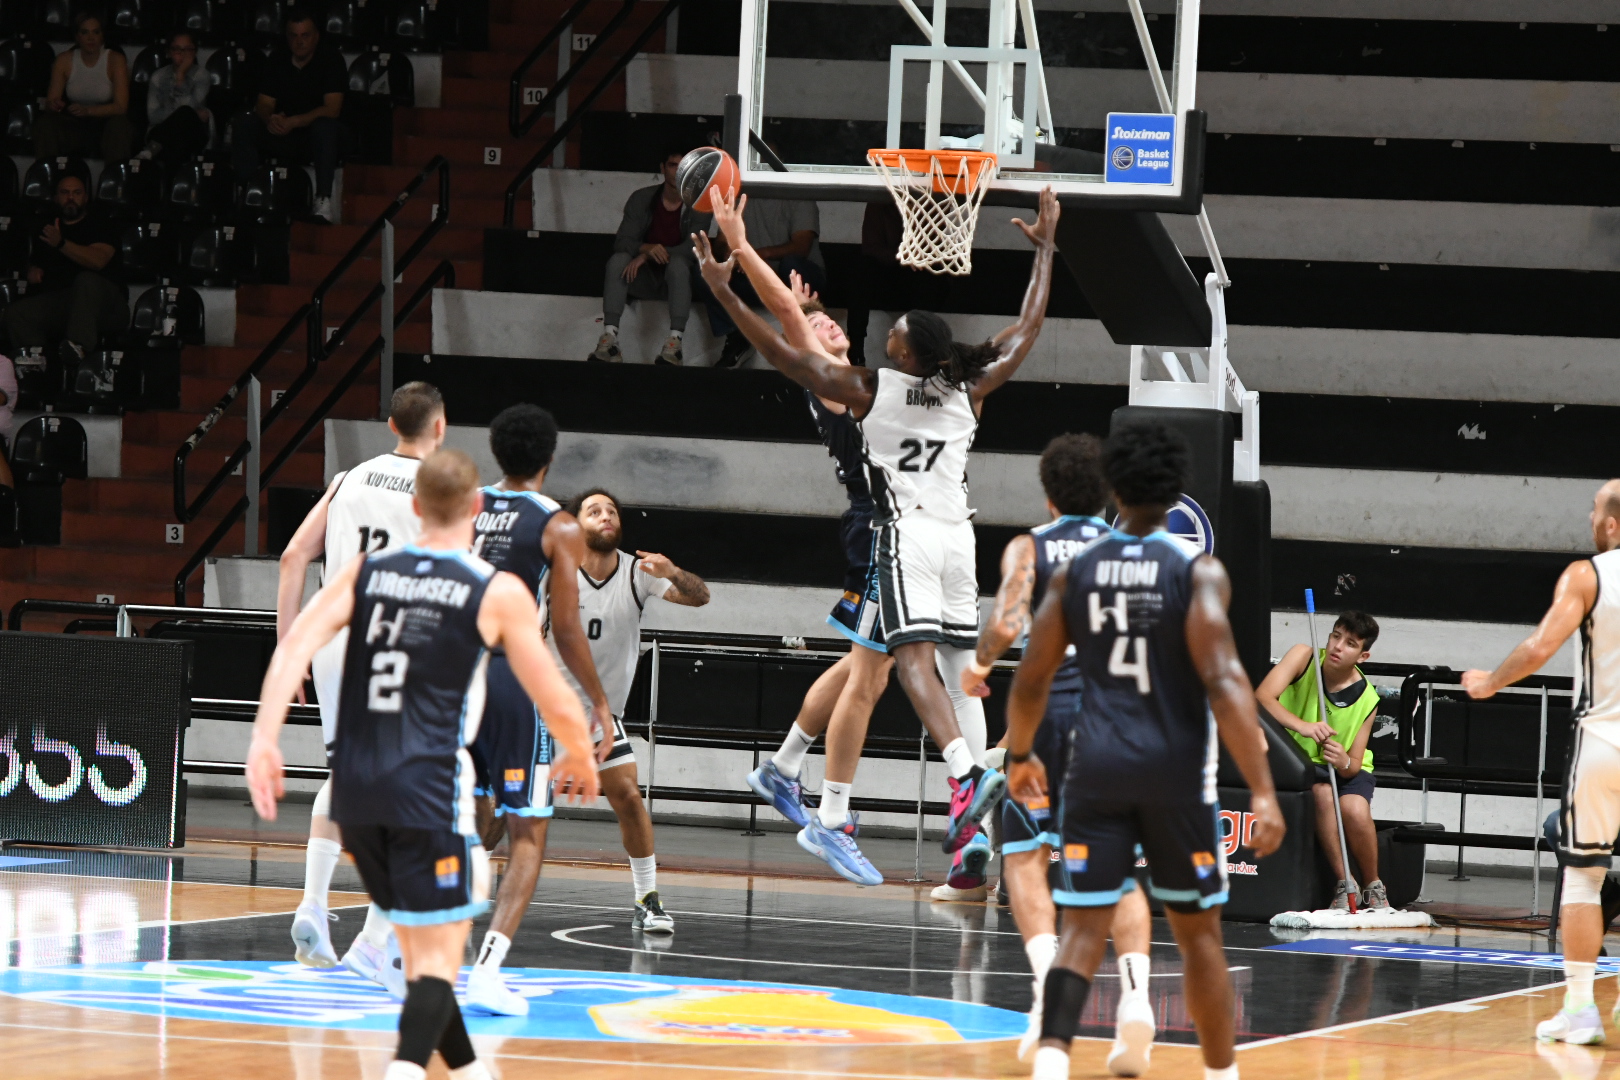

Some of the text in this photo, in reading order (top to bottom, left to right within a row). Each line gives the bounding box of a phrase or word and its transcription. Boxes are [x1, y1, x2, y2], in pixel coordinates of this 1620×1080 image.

[527, 90, 543, 103] 10
[1111, 126, 1171, 140] Stoiximan
[488, 149, 497, 162] 9
[1137, 148, 1170, 159] Basket
[1137, 158, 1170, 170] League
[898, 437, 947, 473] 27
[170, 526, 180, 541] 3
[358, 526, 390, 554] 12
[1095, 560, 1159, 587] UTOMI
[588, 618, 602, 640] 0
[1109, 636, 1151, 695] 4
[367, 651, 410, 712] 2
